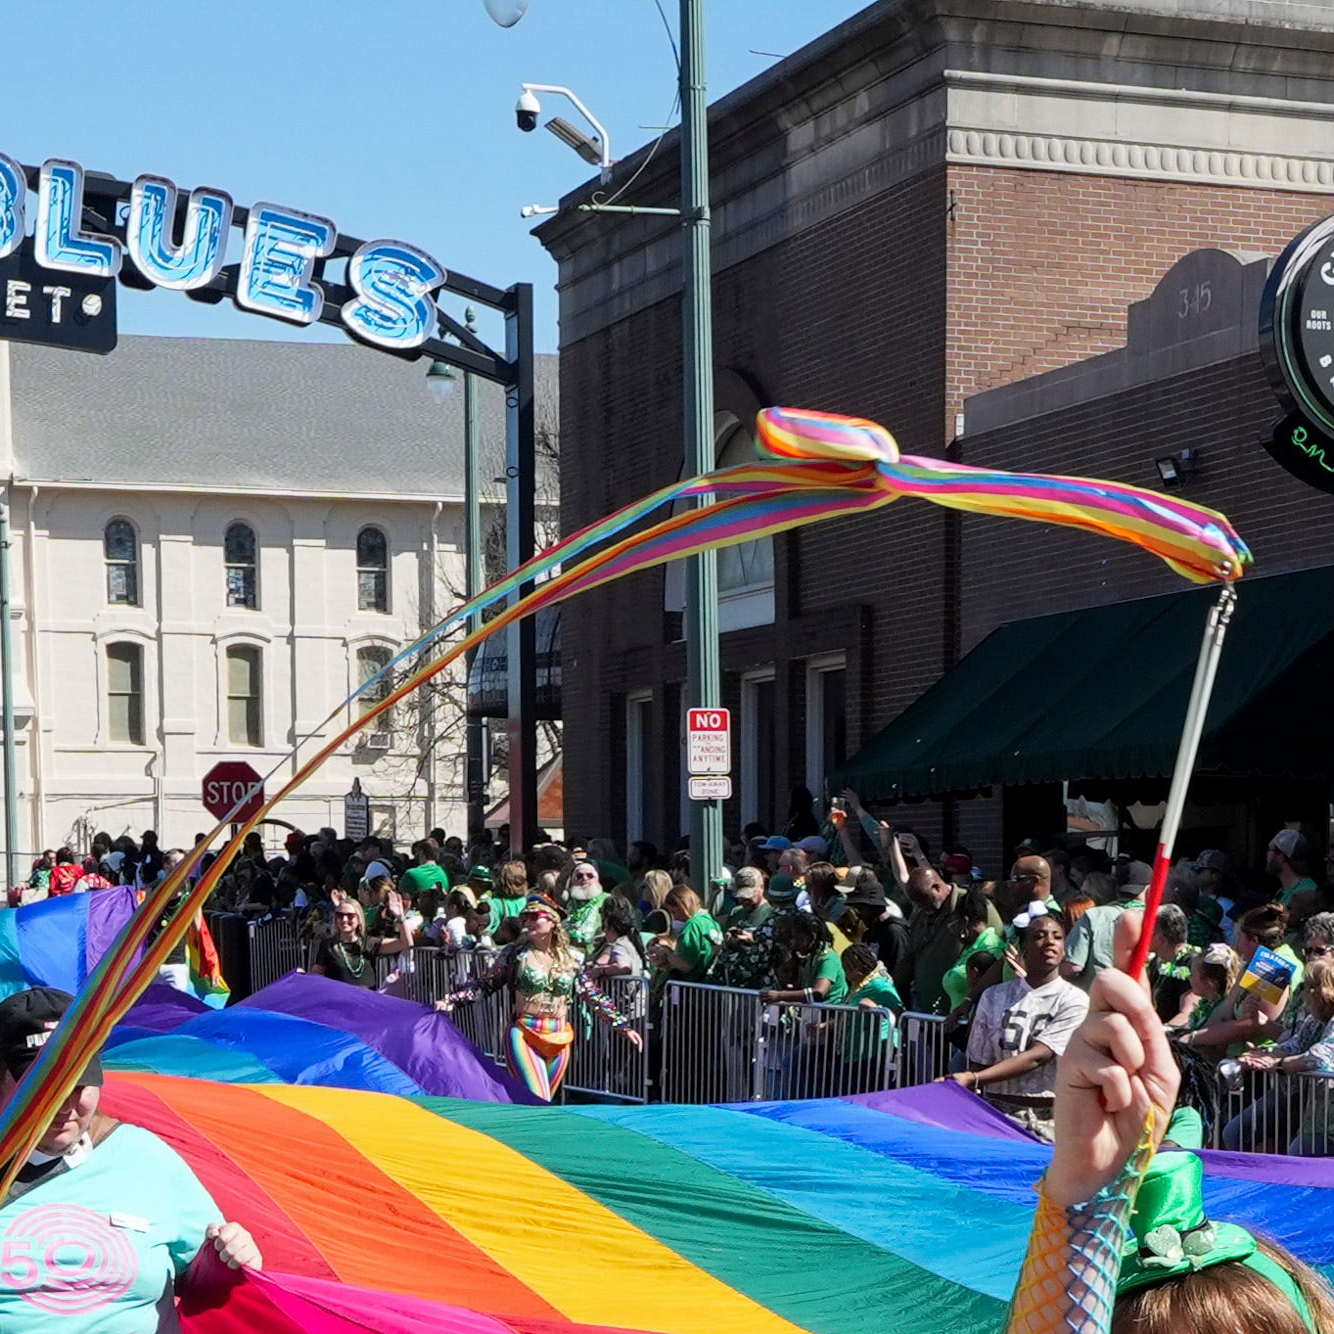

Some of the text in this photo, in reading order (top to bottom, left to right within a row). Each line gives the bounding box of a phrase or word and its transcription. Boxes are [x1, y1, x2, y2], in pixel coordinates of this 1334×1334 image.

[1310, 310, 1327, 320] OUR
[1306, 320, 1332, 331] ROOTS
[696, 713, 722, 729] NO
[692, 734, 724, 742] PARKING
[693, 746, 726, 754] ANDING
[692, 755, 725, 763] ANYTIME
[207, 781, 260, 804] STOP
